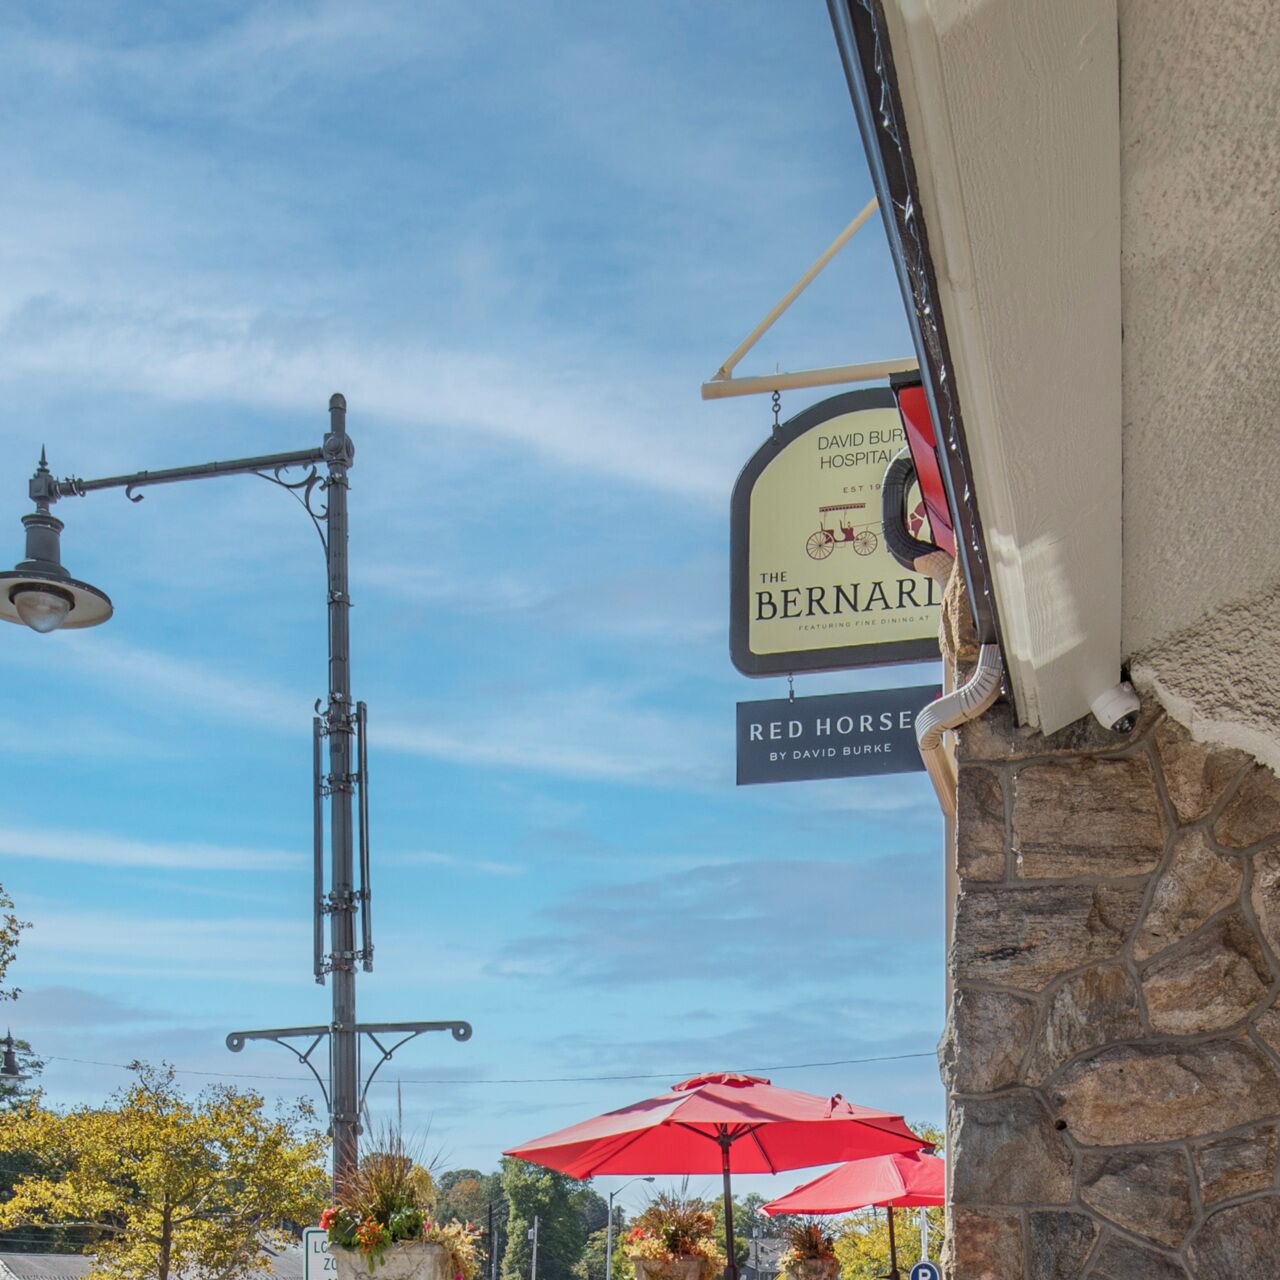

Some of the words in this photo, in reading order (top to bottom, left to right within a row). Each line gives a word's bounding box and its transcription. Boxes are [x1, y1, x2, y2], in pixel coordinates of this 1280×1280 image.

[818, 432, 864, 451] DAVID
[869, 428, 907, 446] BUR
[842, 485, 863, 494] EST
[870, 483, 882, 491] 19
[760, 571, 788, 584] THE
[798, 621, 851, 631] FEATURING
[855, 618, 878, 627] FINE
[880, 616, 915, 625] DINING
[750, 720, 803, 741] RED
[816, 711, 912, 736] HORSE
[770, 751, 787, 761] BY
[793, 747, 836, 760] DAVID
[842, 743, 892, 756] BURKE
[314, 1240, 328, 1253] LO
[323, 1257, 337, 1270] ZO
